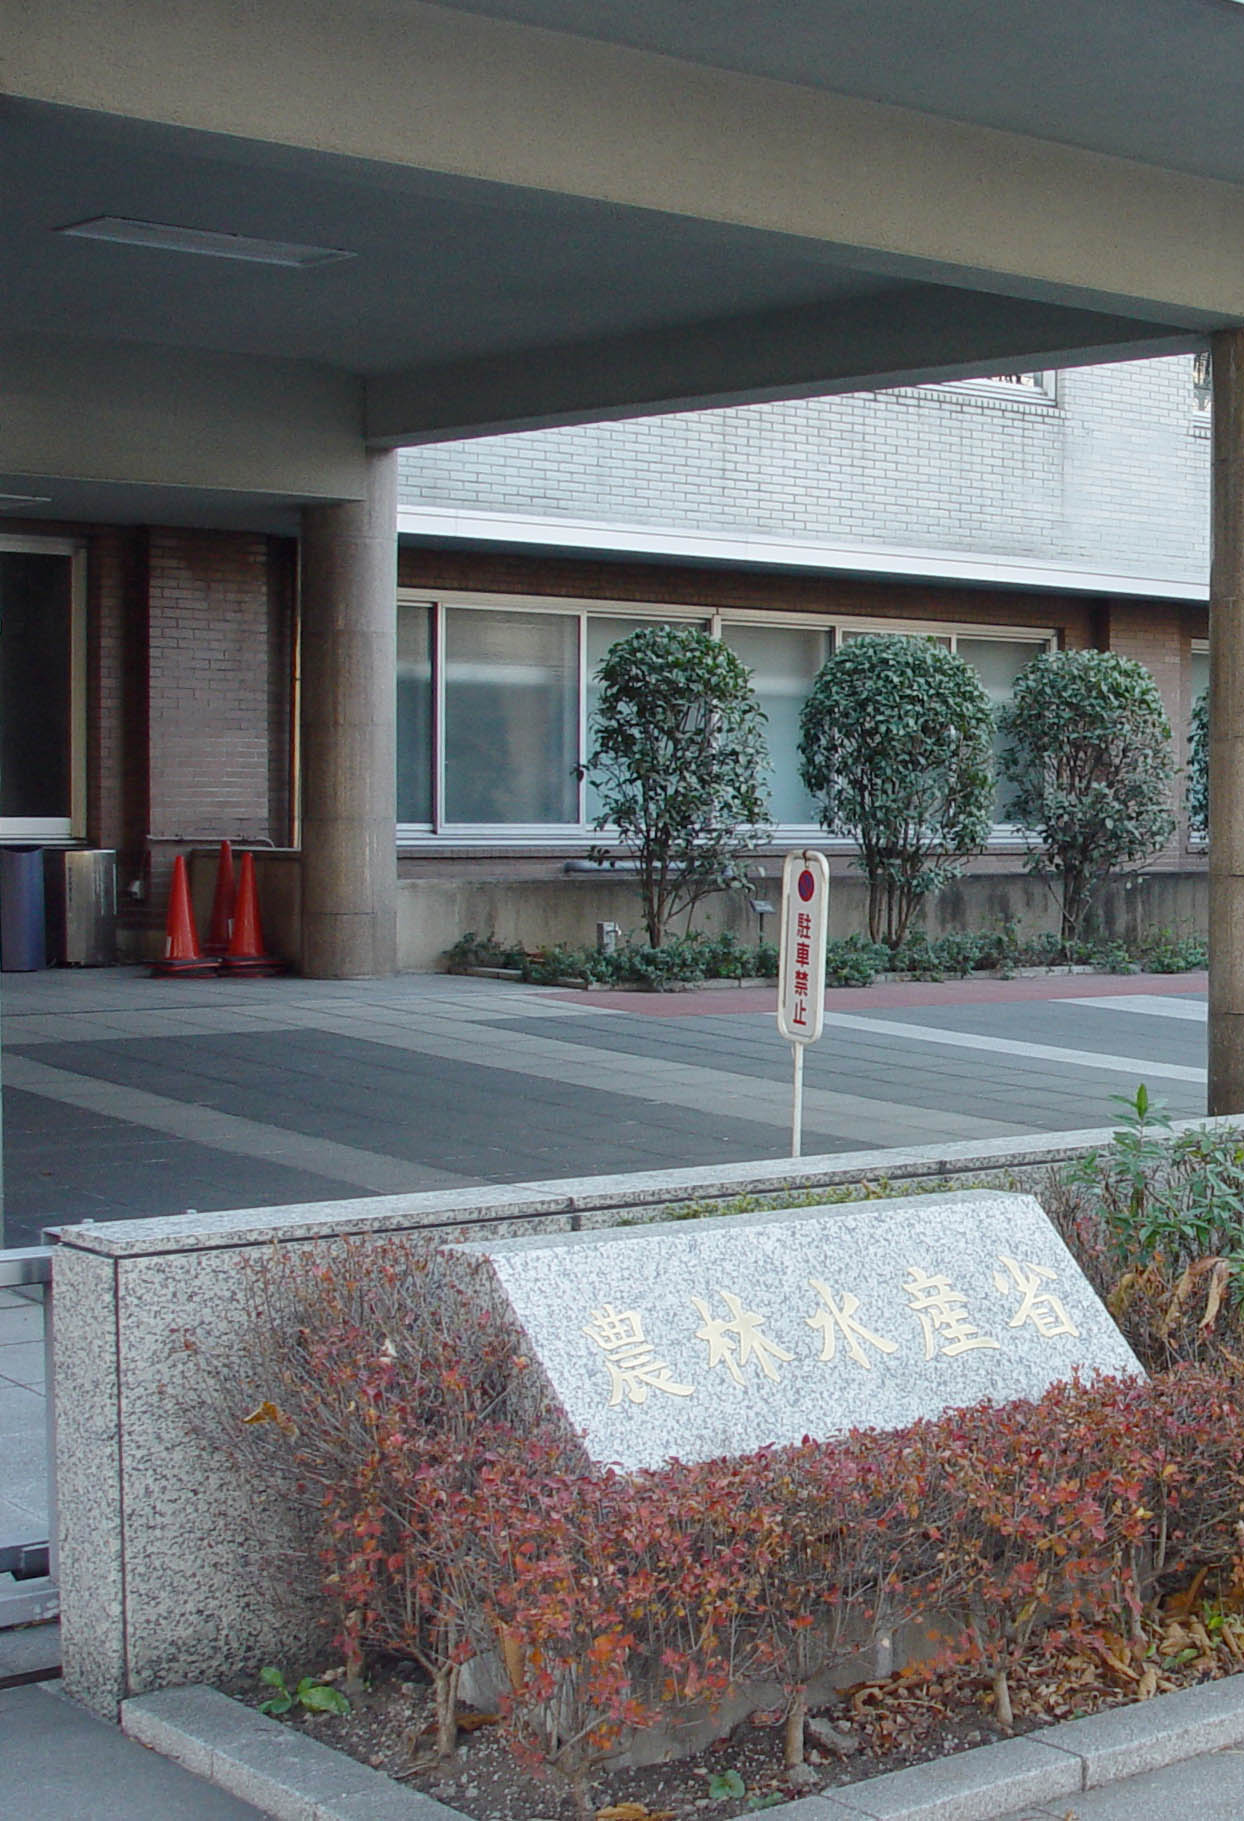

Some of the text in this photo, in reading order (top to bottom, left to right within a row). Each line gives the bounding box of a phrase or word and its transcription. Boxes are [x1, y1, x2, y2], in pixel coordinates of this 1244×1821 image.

[792, 912, 812, 1026] 駐車禁止
[581, 1254, 1079, 1407] 農林水産省
